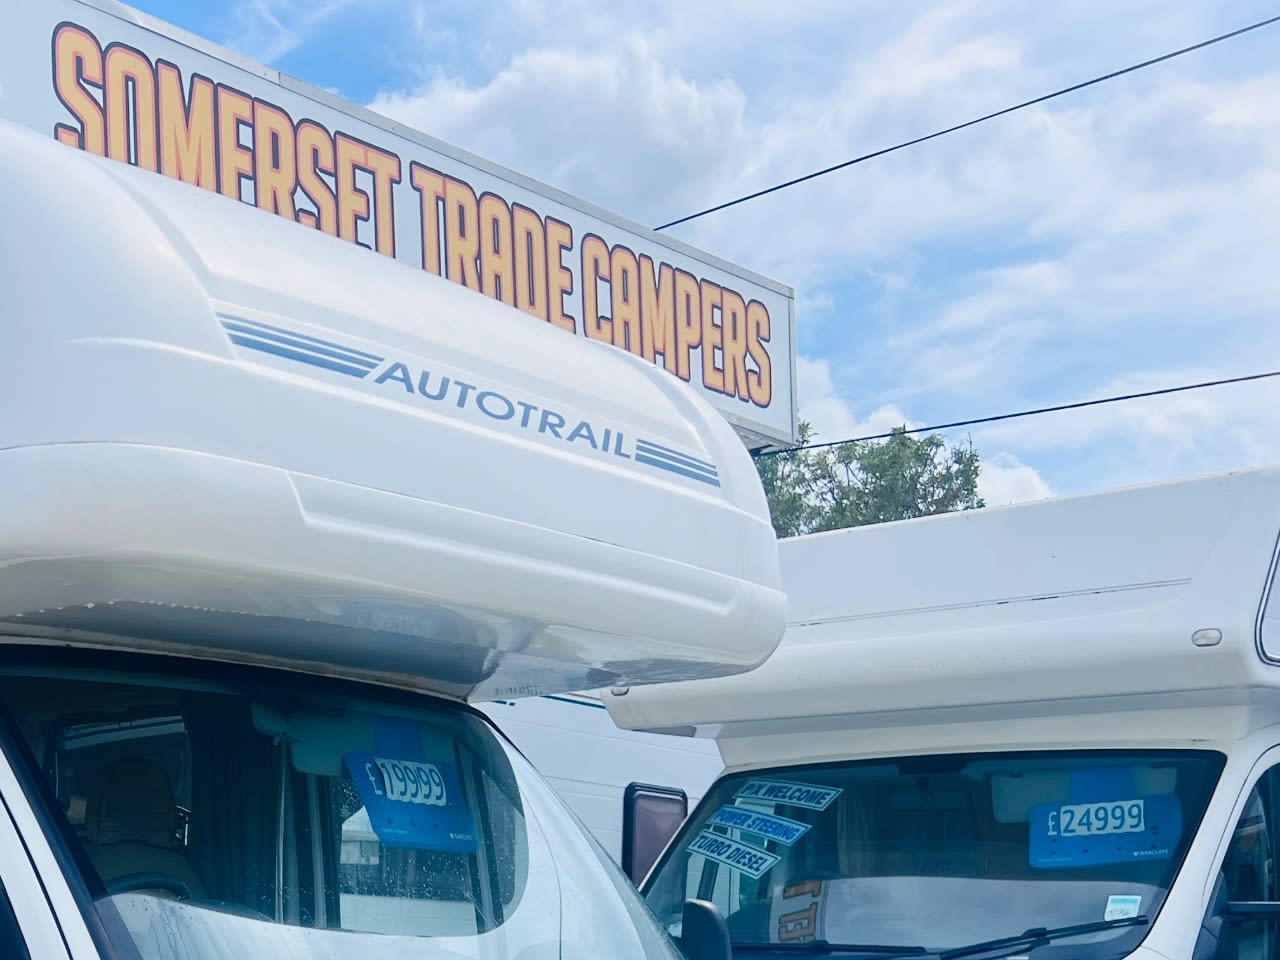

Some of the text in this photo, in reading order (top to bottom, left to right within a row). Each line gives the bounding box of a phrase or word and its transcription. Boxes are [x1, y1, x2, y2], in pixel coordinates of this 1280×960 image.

[51, 21, 772, 408] SOMERSET TRADE CAMPERS
[373, 361, 631, 460] AUTOTRAIL
[365, 760, 445, 801] £19999
[762, 783, 833, 806] WELCOME
[714, 807, 802, 841] POWER STEERING
[1048, 803, 1143, 836] £24999
[692, 834, 768, 873] TURBO DIESEL
